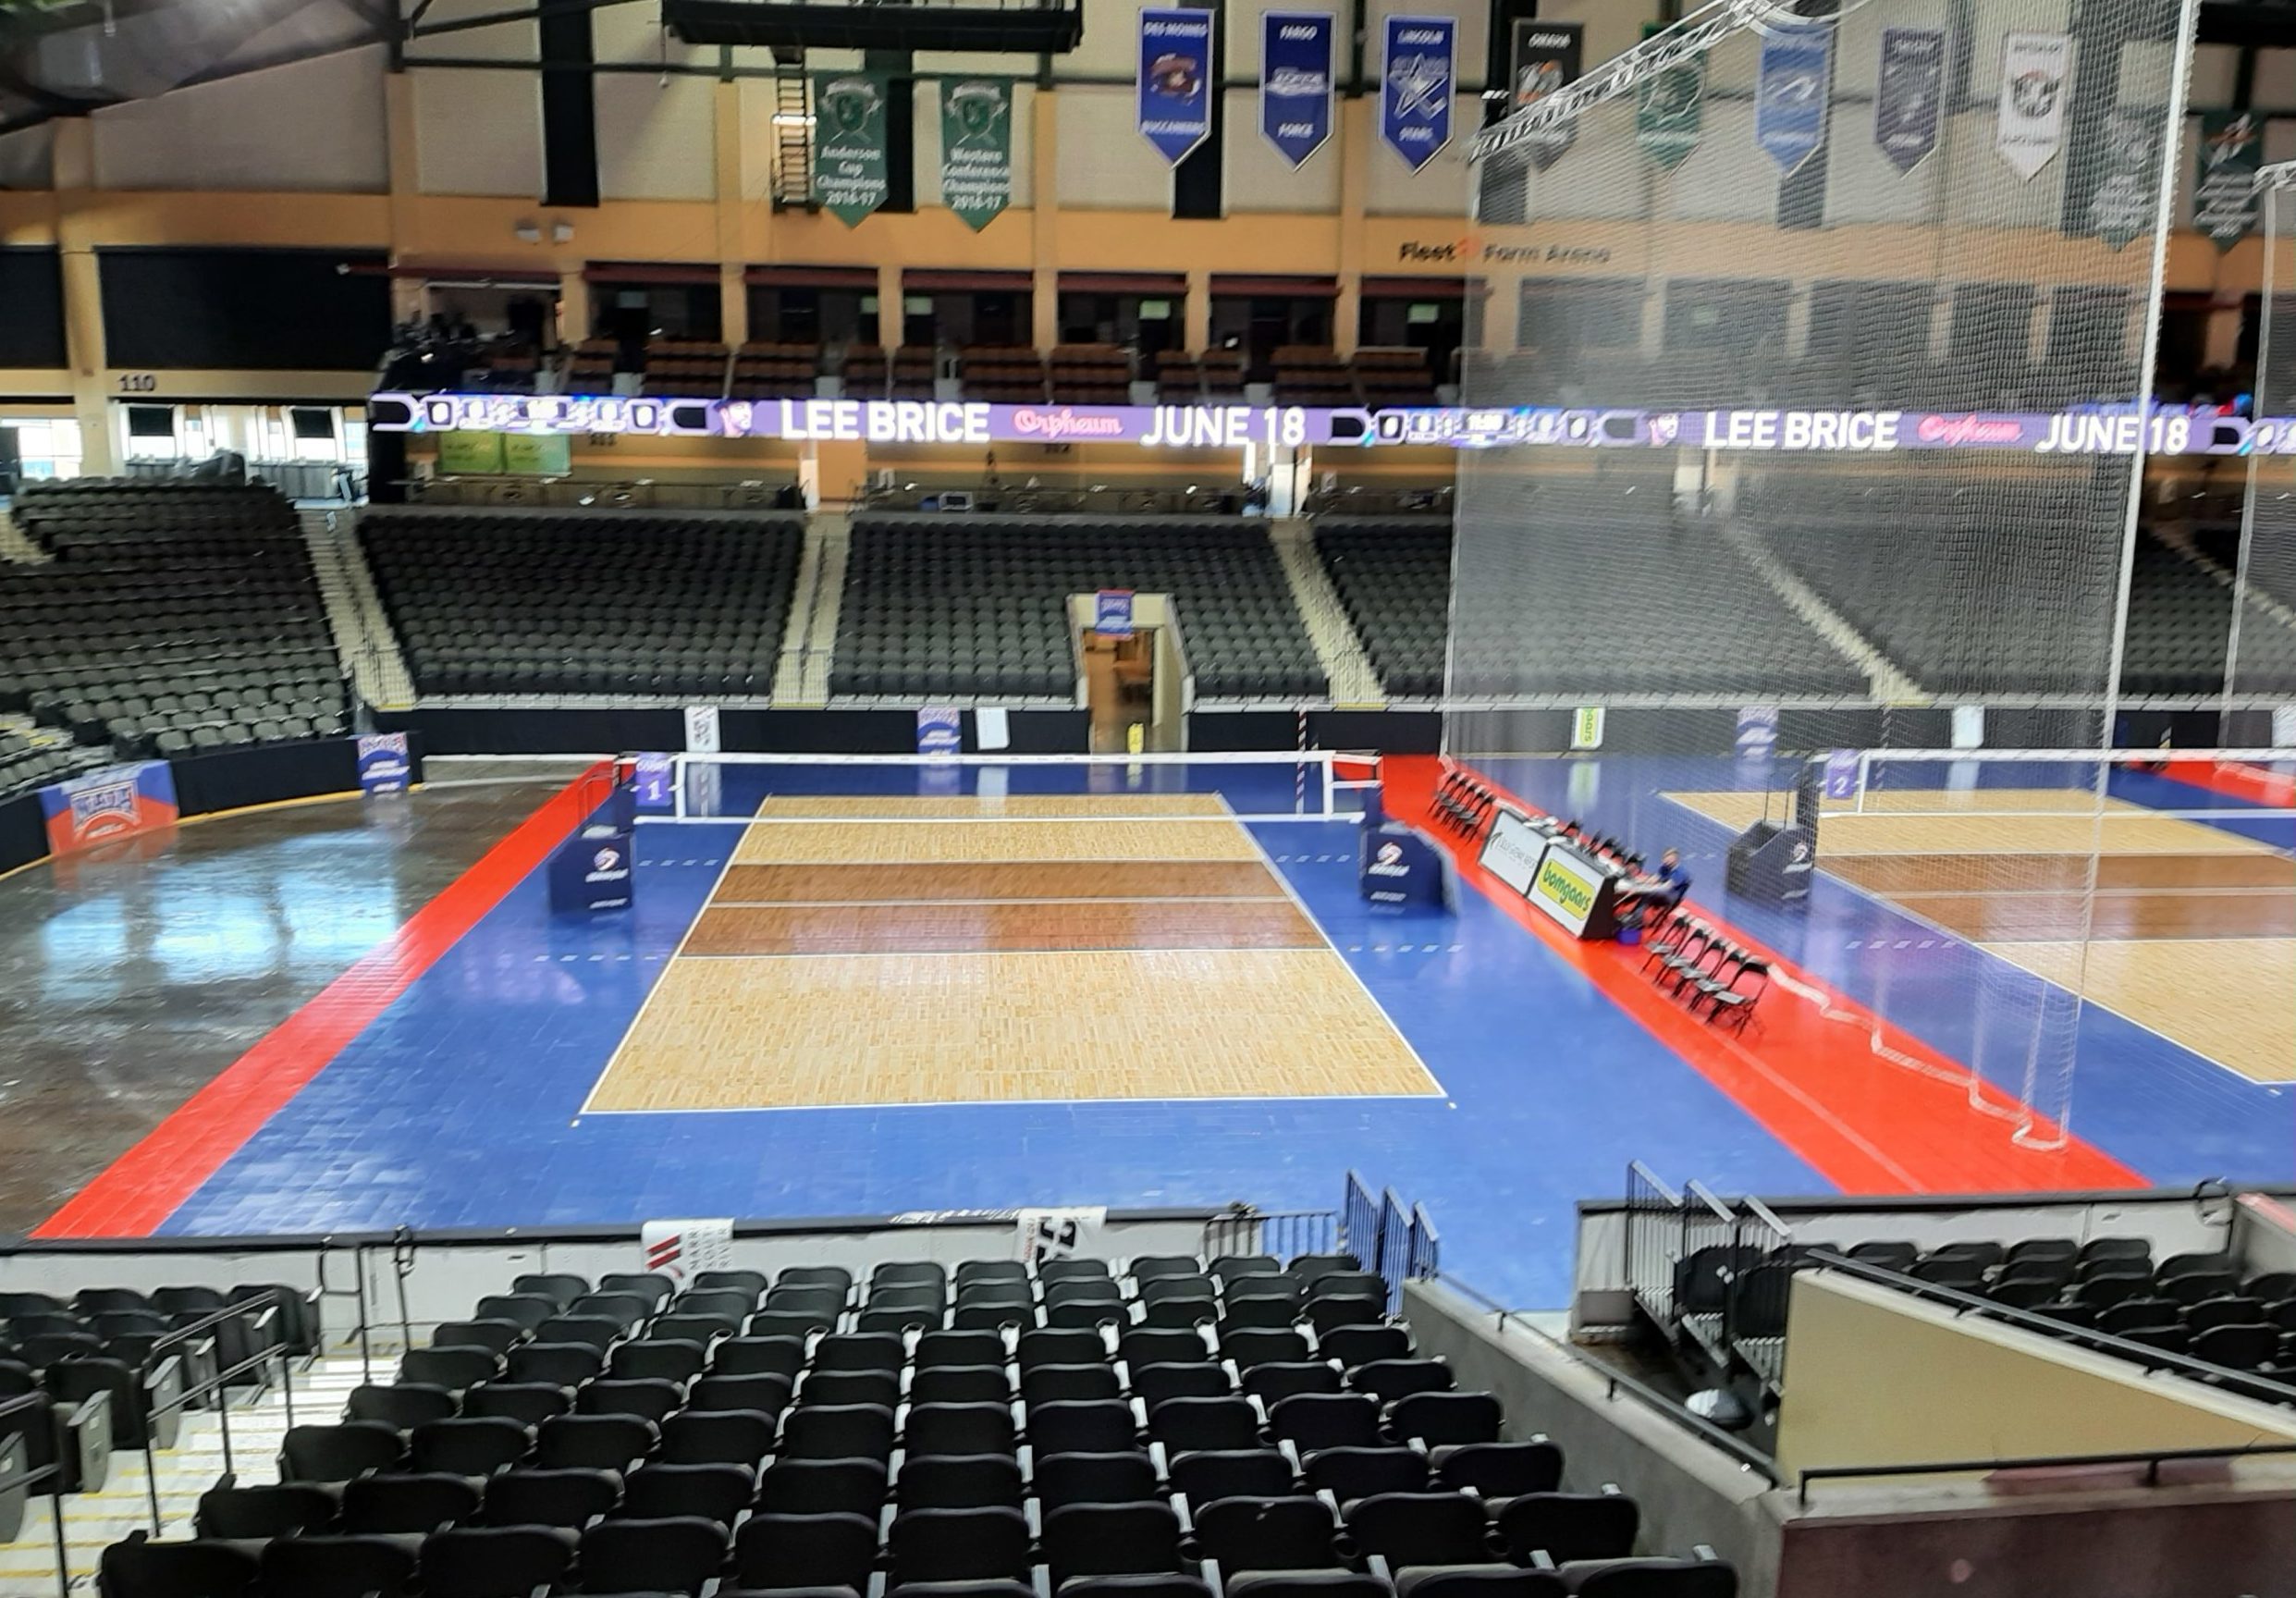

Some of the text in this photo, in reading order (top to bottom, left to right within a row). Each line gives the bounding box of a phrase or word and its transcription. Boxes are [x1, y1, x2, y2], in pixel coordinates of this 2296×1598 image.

[821, 146, 881, 161] Anderson
[951, 148, 1002, 163] Western
[840, 162, 864, 177] Cup
[942, 164, 1011, 178] Conference
[817, 176, 885, 191] Champions
[942, 179, 1011, 195] Champions
[1399, 240, 1455, 262] Fleet
[1484, 243, 1540, 262] Farm
[118, 375, 155, 391] 110
[781, 399, 991, 443] LEE BRICE
[1014, 409, 1123, 438] Orpheum
[1140, 405, 1305, 446] JUNE 18
[1704, 411, 1901, 450] LEE BRICE
[2036, 414, 2192, 454] JUNE 18
[647, 780, 662, 801] 1
[1834, 776, 1849, 794] 2
[1542, 862, 1591, 912] bomgaars
